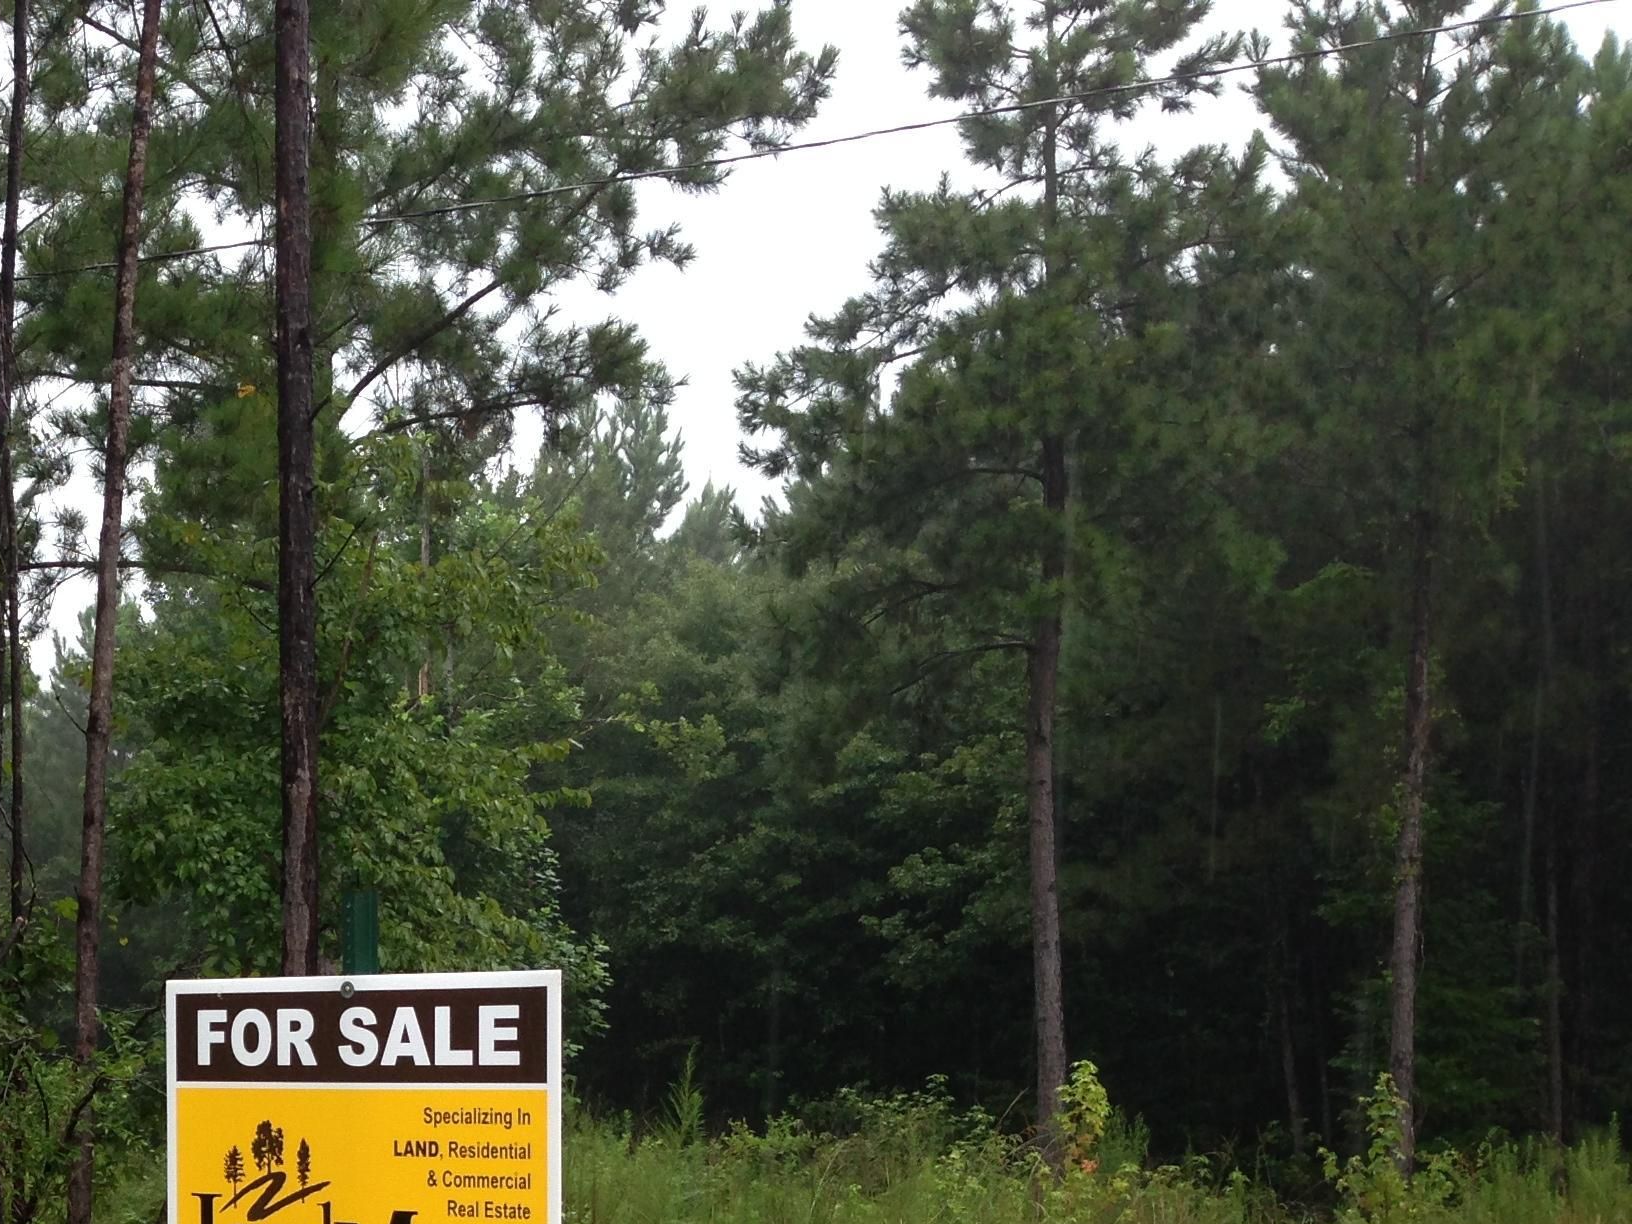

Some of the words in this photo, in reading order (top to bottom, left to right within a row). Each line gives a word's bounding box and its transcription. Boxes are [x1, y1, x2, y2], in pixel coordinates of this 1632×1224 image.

[197, 1008, 317, 1067] FOR
[338, 1004, 521, 1067] SALE
[423, 1106, 512, 1129] Specializing
[517, 1107, 531, 1125] In
[393, 1140, 444, 1160] LAND,
[448, 1141, 531, 1160] Residential
[427, 1169, 438, 1187] &
[442, 1170, 531, 1190] Commercial
[447, 1199, 479, 1218] Real
[484, 1201, 531, 1220] Estate
